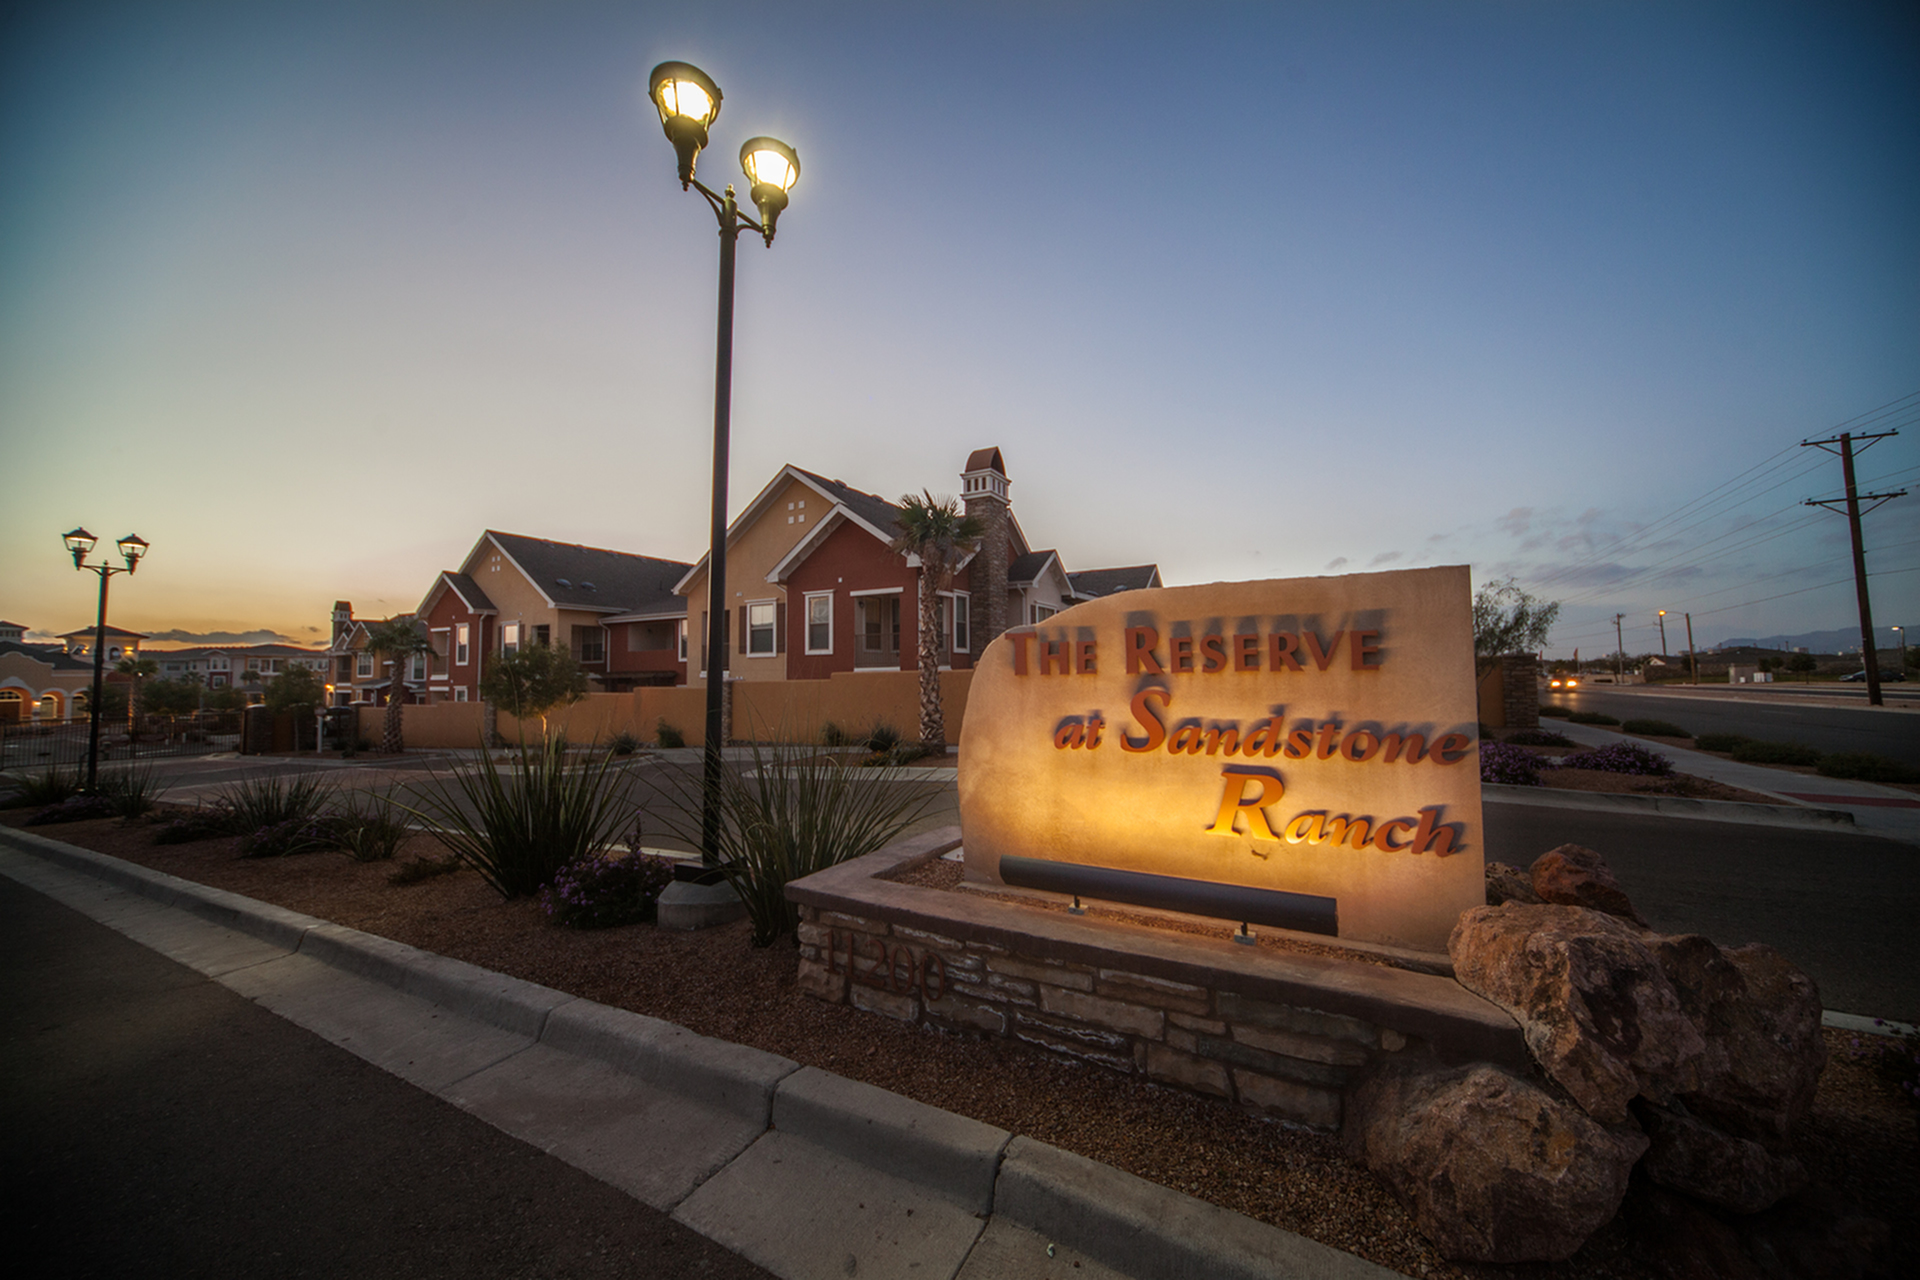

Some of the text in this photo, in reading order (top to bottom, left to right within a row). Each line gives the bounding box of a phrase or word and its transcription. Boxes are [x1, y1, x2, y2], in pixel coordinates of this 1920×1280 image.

[1005, 626, 1382, 676] THE RESERVE
[1054, 689, 1471, 765] at Sandstone
[1205, 771, 1461, 858] Ranch
[822, 929, 944, 1001] 11200
